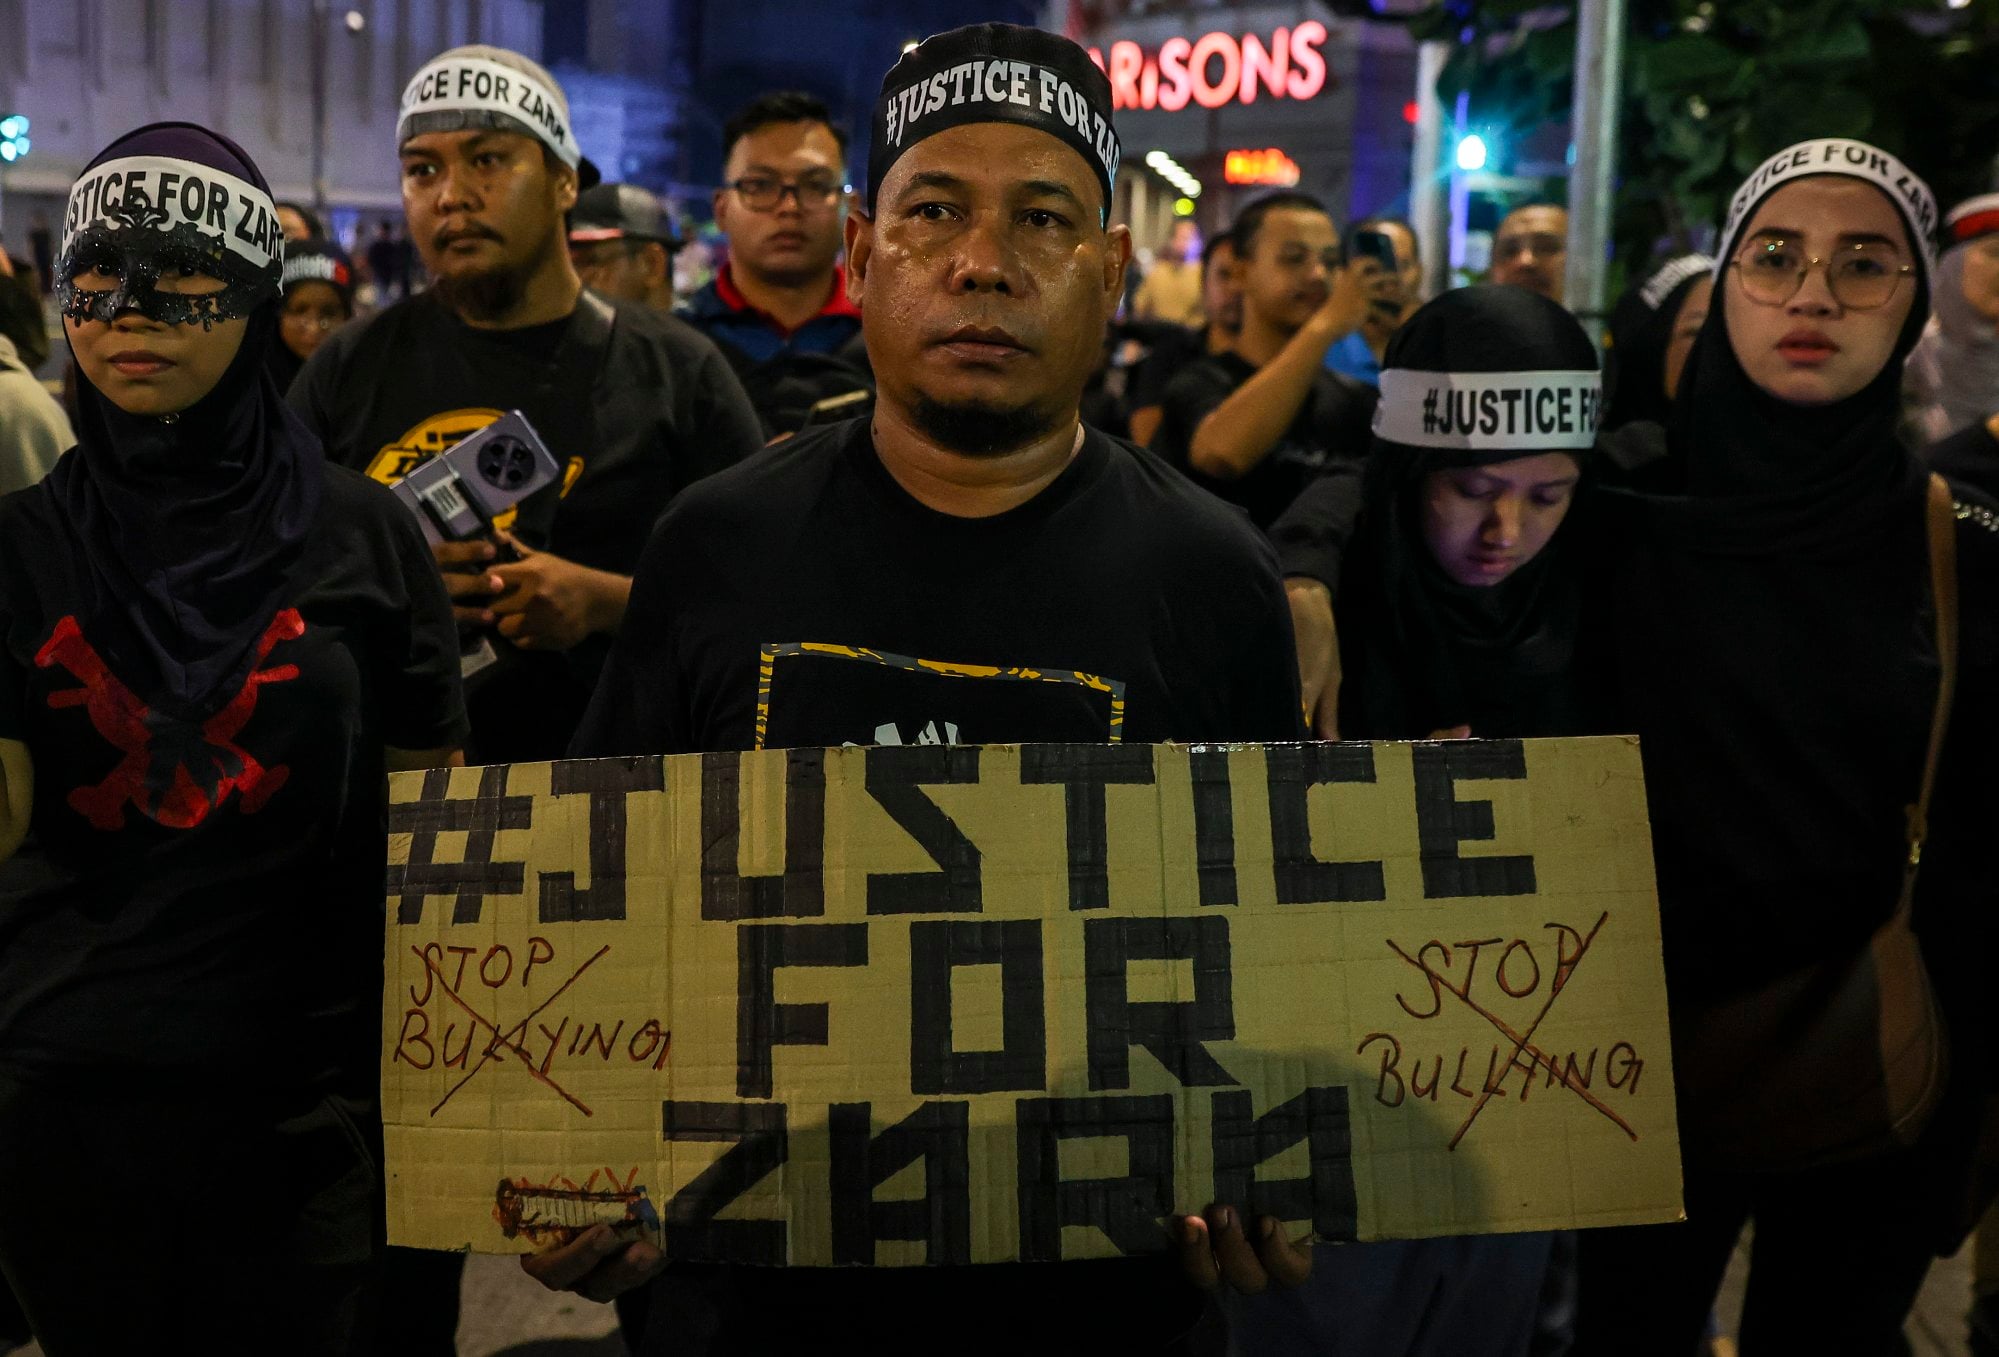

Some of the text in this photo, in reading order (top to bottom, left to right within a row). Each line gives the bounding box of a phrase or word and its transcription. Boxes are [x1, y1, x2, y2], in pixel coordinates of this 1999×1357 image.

[458, 68, 509, 103] FOR
[886, 60, 1031, 147] #JUSTICE
[1040, 69, 1092, 145] FOR
[1823, 145, 1888, 176] FOR
[157, 172, 230, 232] FOR
[235, 194, 282, 259] ZAR
[1423, 387, 1573, 435] #JUSTICE
[387, 739, 1536, 925] #JUSTICE
[410, 936, 554, 1007] STOP
[736, 914, 1241, 1098] FOR
[1395, 922, 1583, 1019] STOP
[393, 1008, 671, 1077] BULLYING
[1356, 1032, 1644, 1108] BULLYING
[662, 1085, 1358, 1267] ZARA
